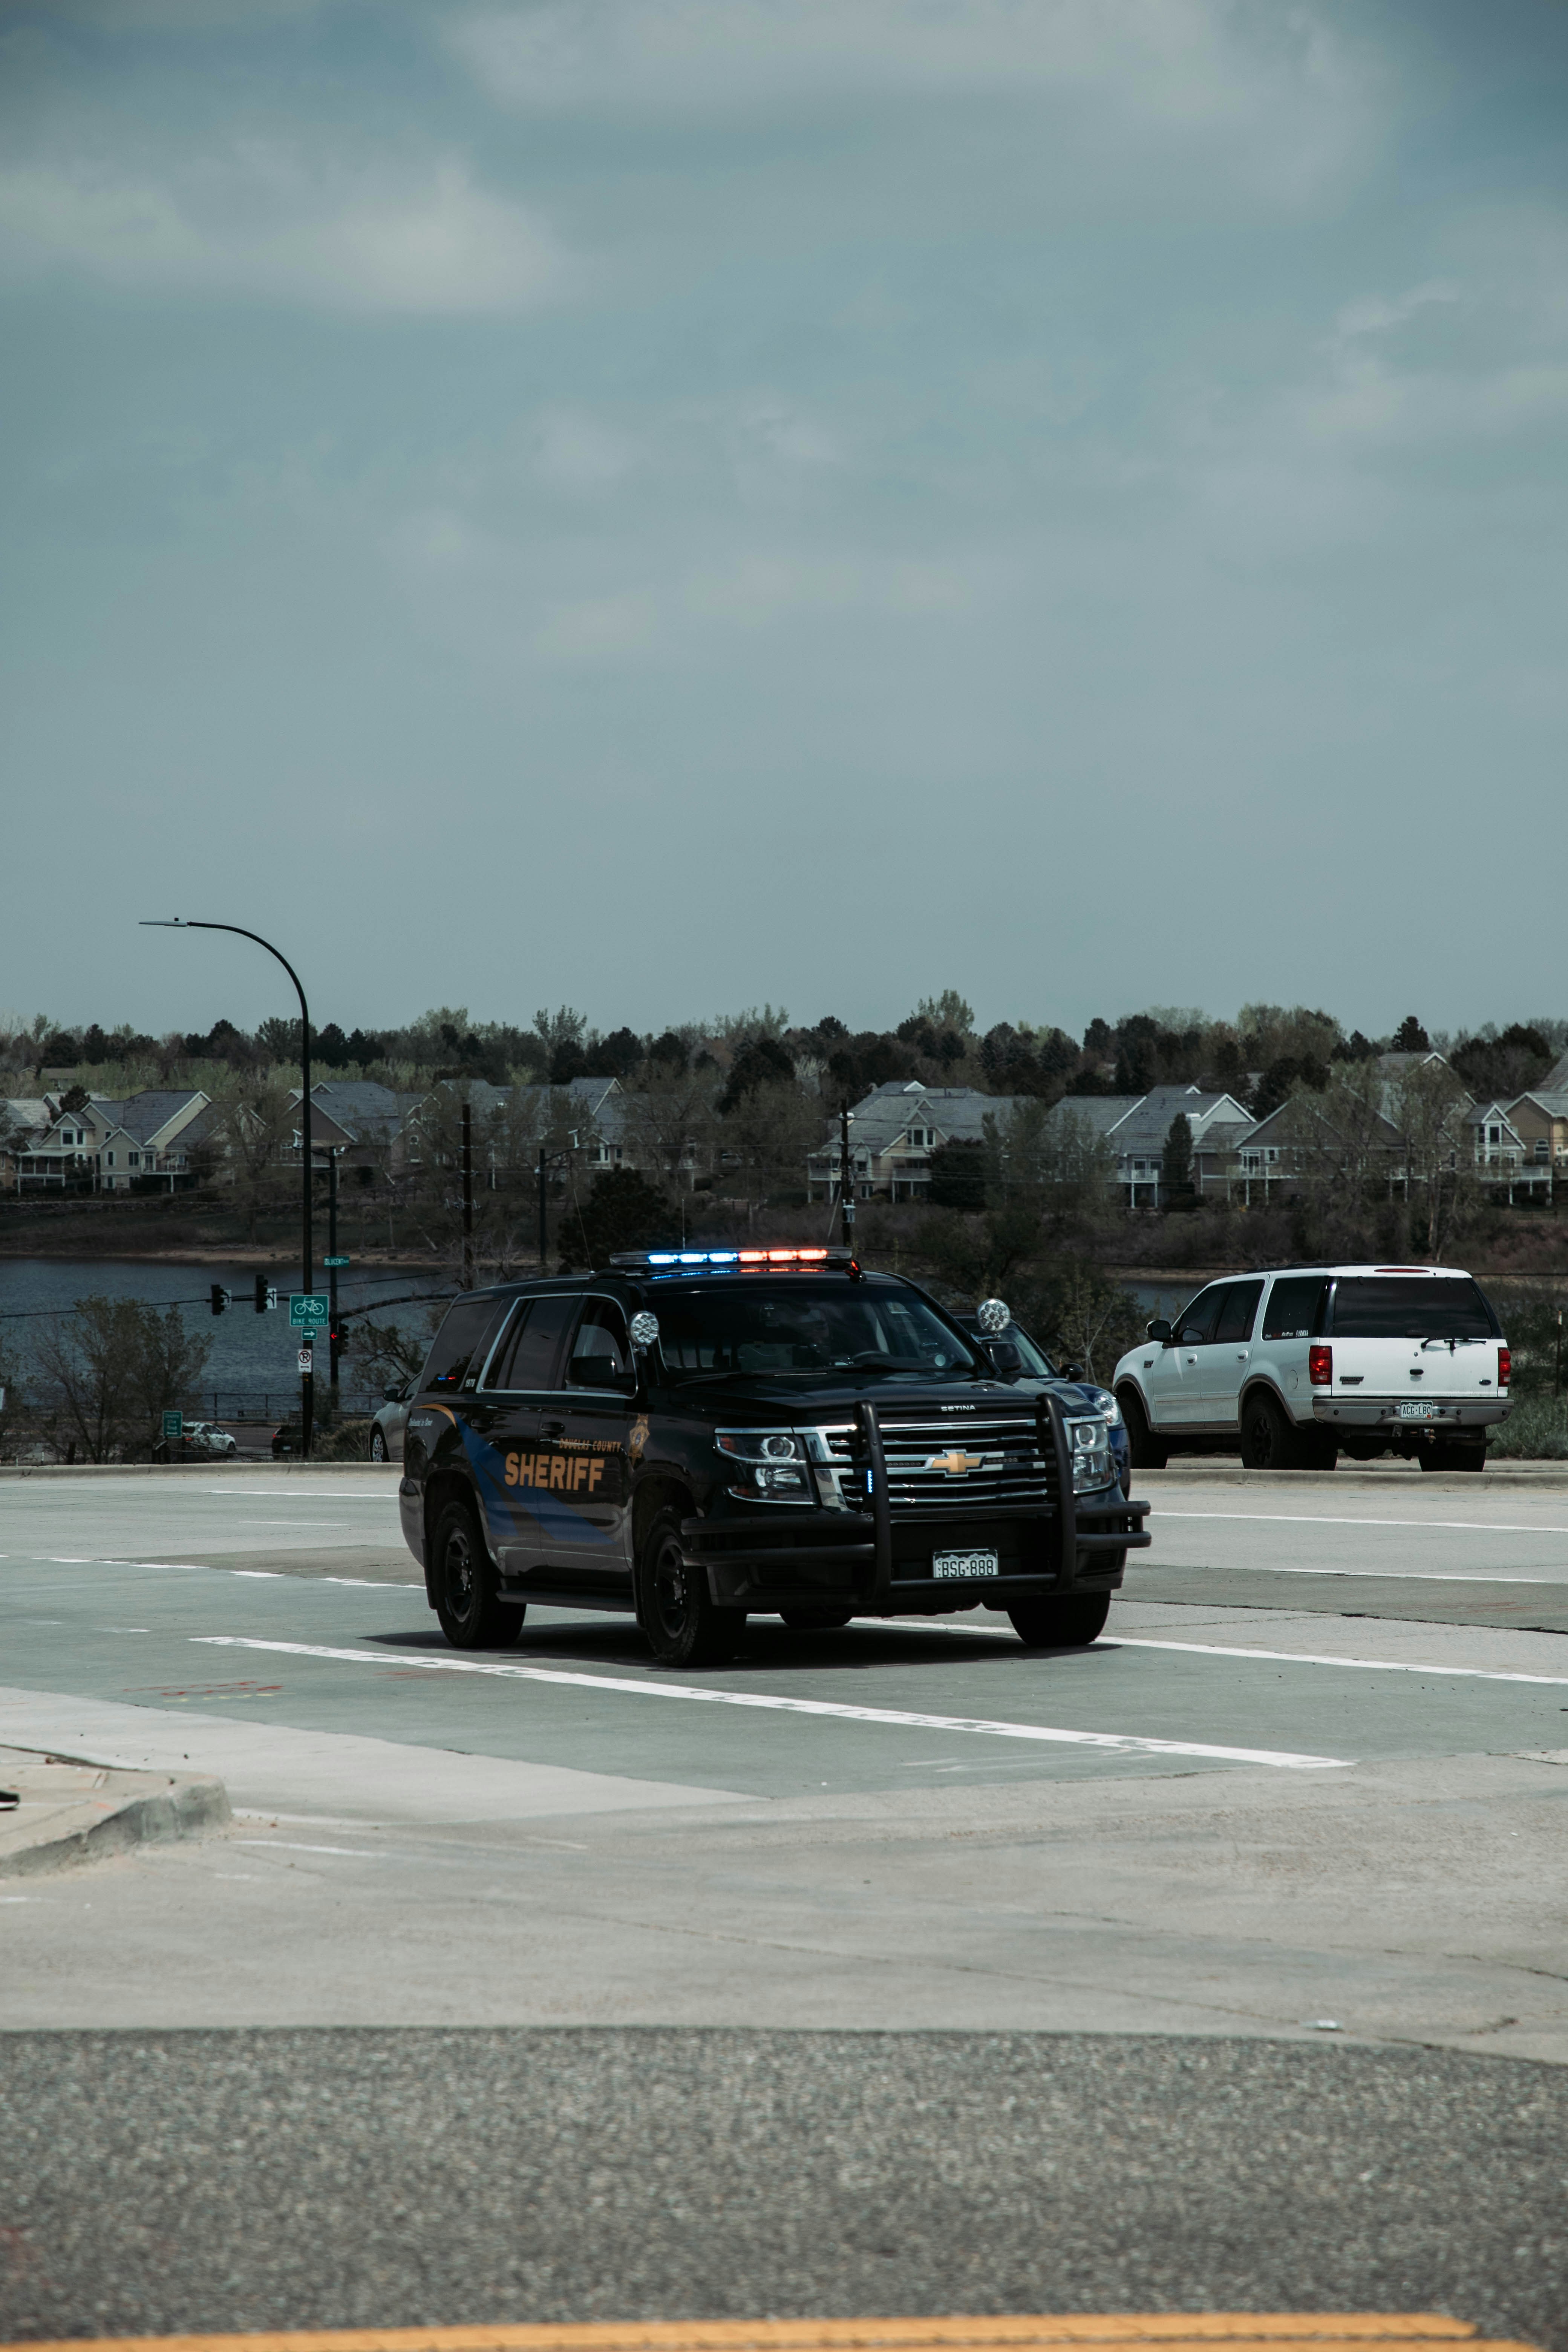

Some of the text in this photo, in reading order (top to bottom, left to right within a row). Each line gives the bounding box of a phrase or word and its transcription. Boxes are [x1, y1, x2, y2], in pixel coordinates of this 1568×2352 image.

[559, 1438, 622, 1452] DOUGLAS COUNTY
[504, 1452, 605, 1491] SHERIFF
